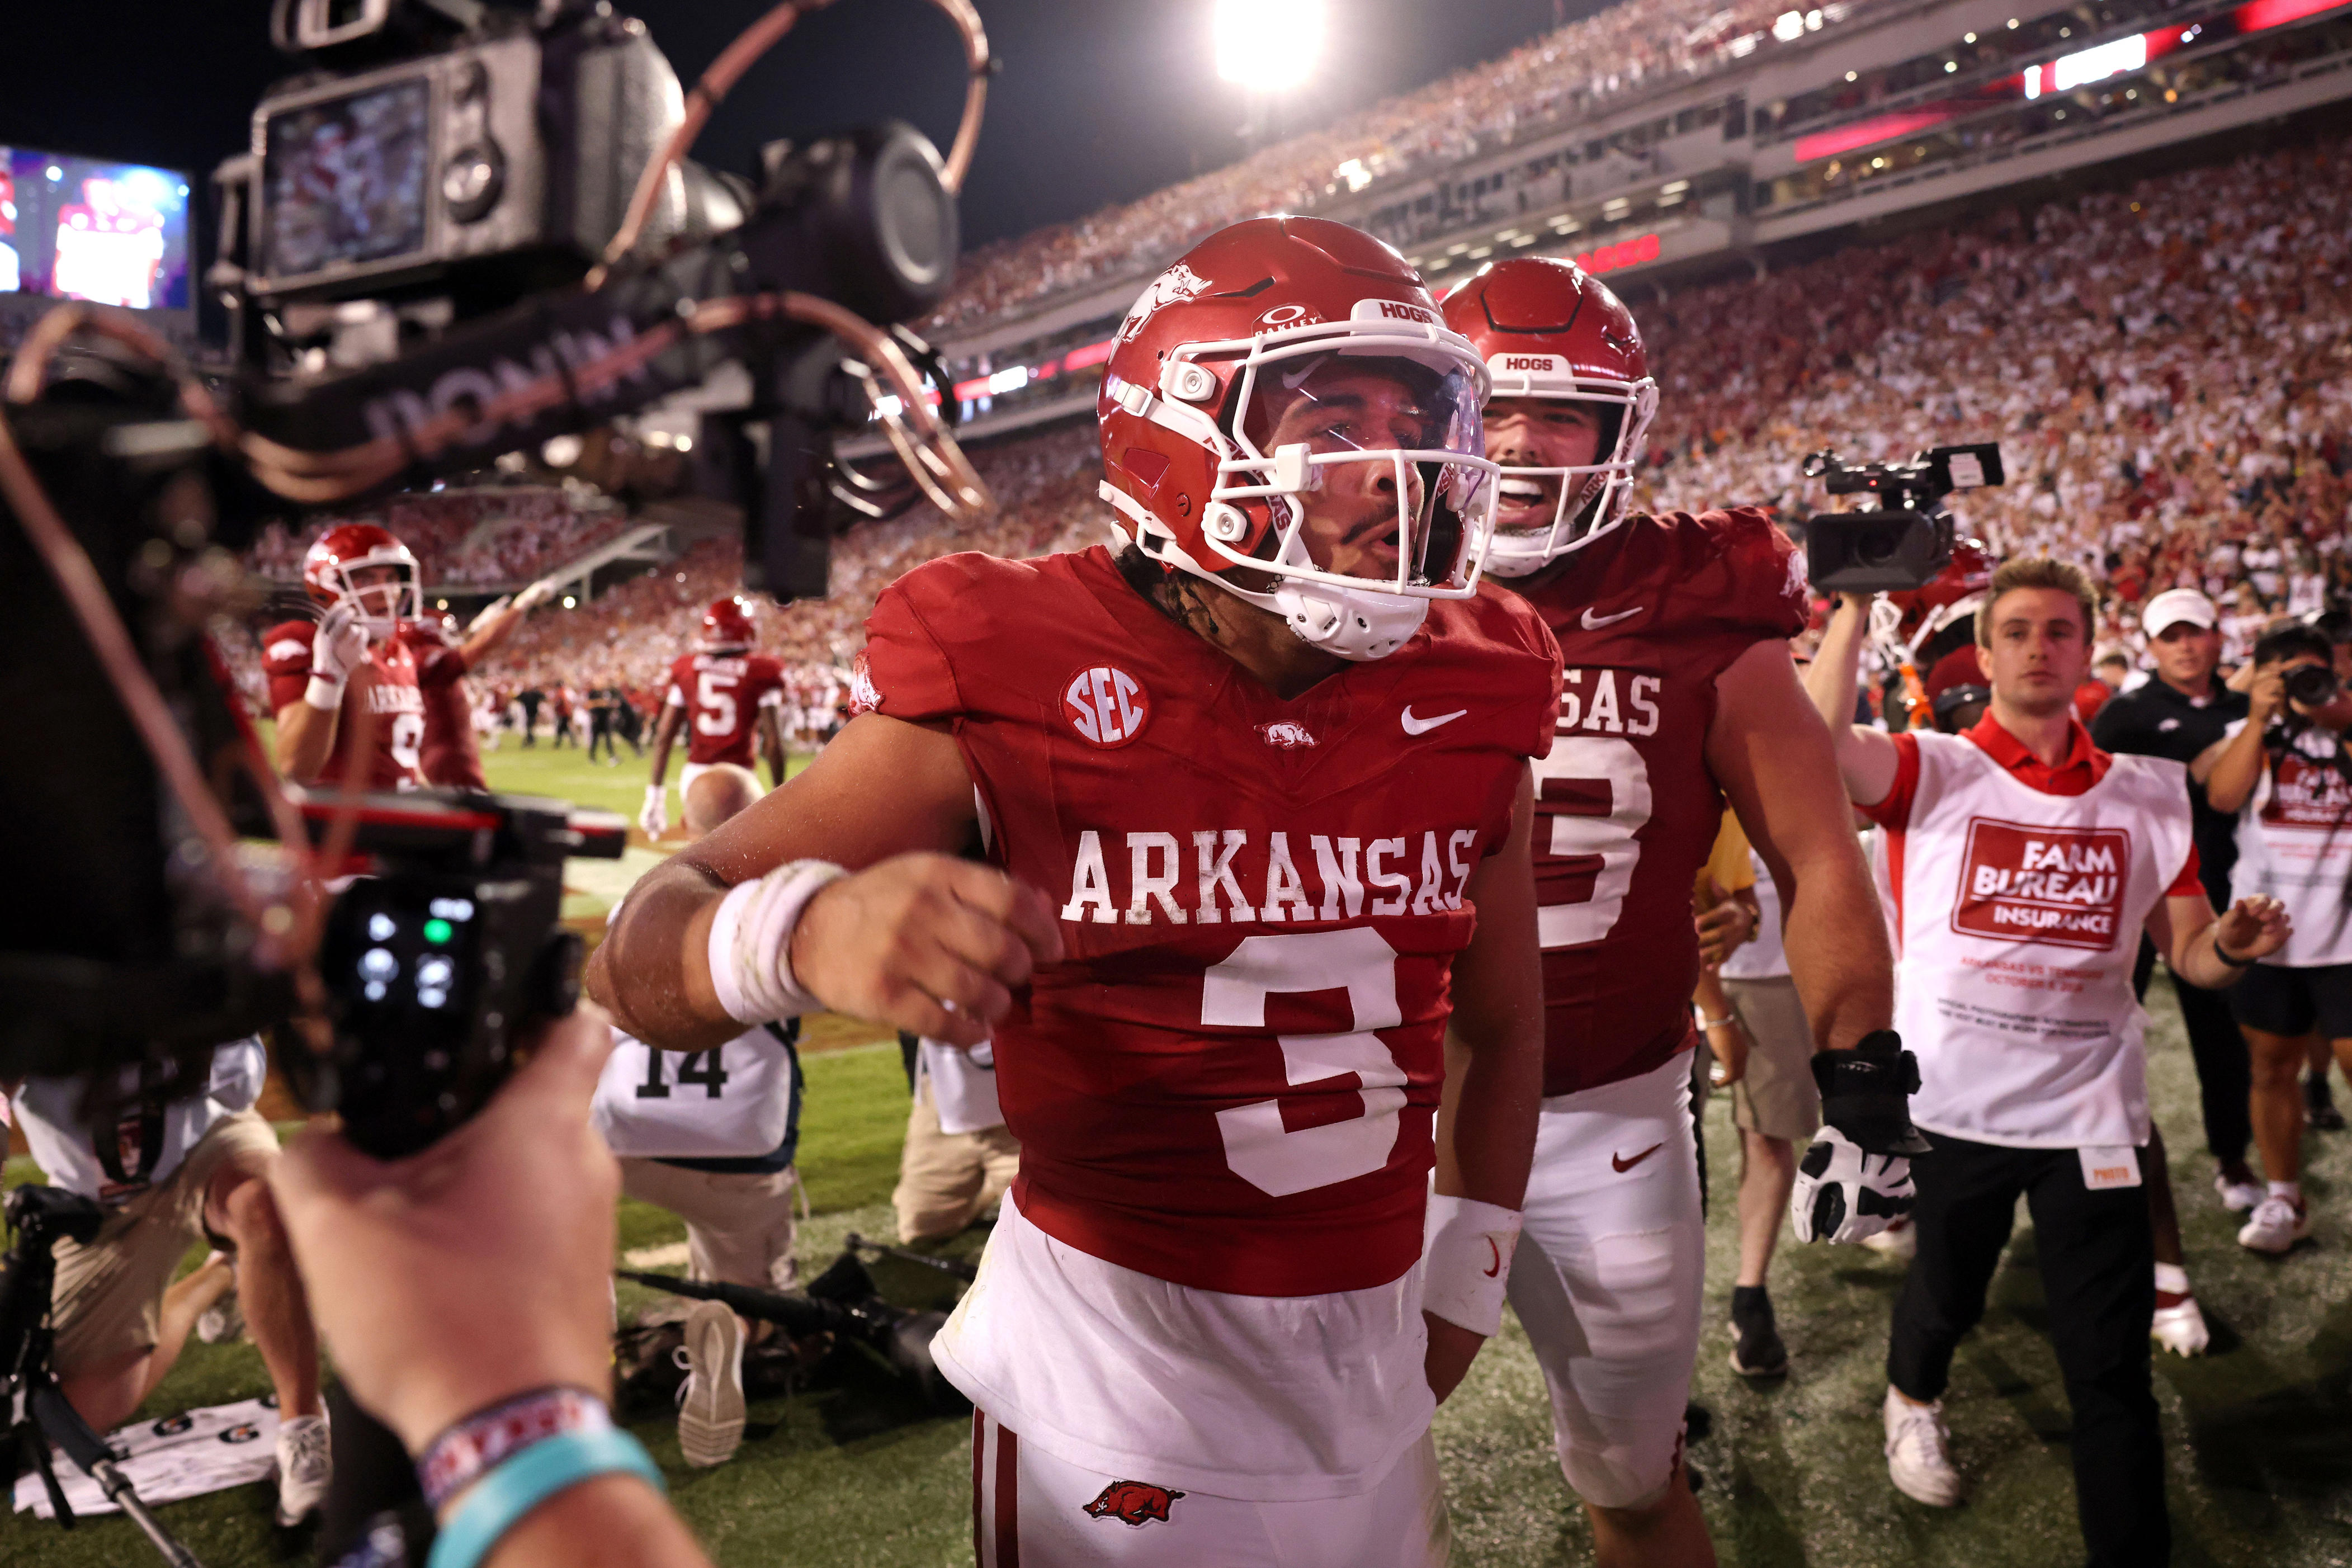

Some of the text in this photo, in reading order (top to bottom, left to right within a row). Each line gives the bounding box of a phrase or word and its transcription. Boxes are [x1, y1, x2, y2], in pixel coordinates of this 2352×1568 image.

[1379, 302, 1433, 324] HOGS
[1506, 358, 1552, 371] HOGS
[697, 673, 739, 736] 5
[1066, 668, 1144, 743] SEC
[1060, 829, 1478, 925] ARKANSAS
[2022, 840, 2116, 873] FARM
[1973, 865, 2118, 905] BUREAU
[1993, 905, 2112, 934] INSURANCE
[636, 1047, 728, 1098] 14
[1201, 926, 1408, 1197] 3
